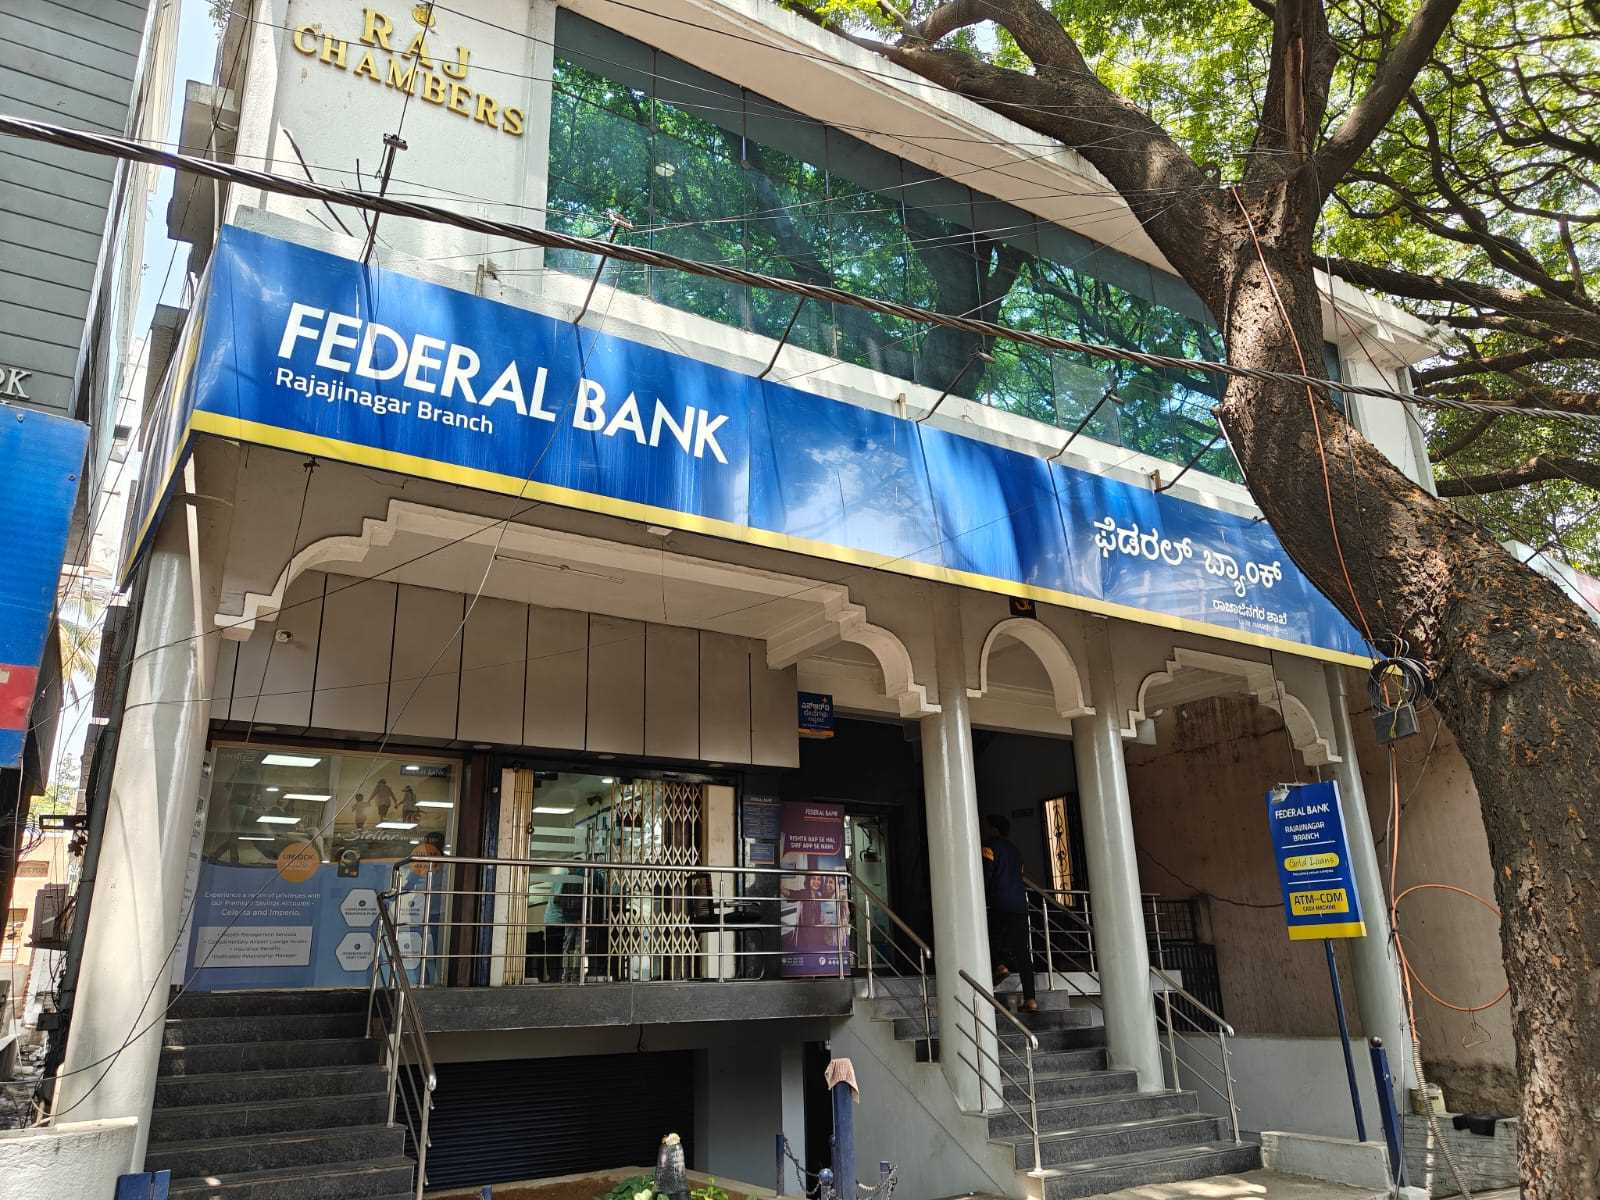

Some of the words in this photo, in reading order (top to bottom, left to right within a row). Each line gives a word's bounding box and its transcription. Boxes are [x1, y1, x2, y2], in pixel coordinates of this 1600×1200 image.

[360, 8, 471, 80] RAJ
[293, 24, 525, 136] CHAMBERS
[0, 366, 32, 399] K
[275, 367, 411, 416] Rajajinagar
[418, 401, 493, 434] Branch
[278, 302, 556, 421] FEDERAL
[573, 378, 729, 464] BANK
[1203, 550, 1282, 597] ಬ್ಯಾಂಕ್
[805, 808, 824, 816] FEDERAL
[1275, 807, 1306, 820] FEDERAL
[1307, 803, 1330, 815] BANK
[1293, 832, 1320, 842] BRANCH
